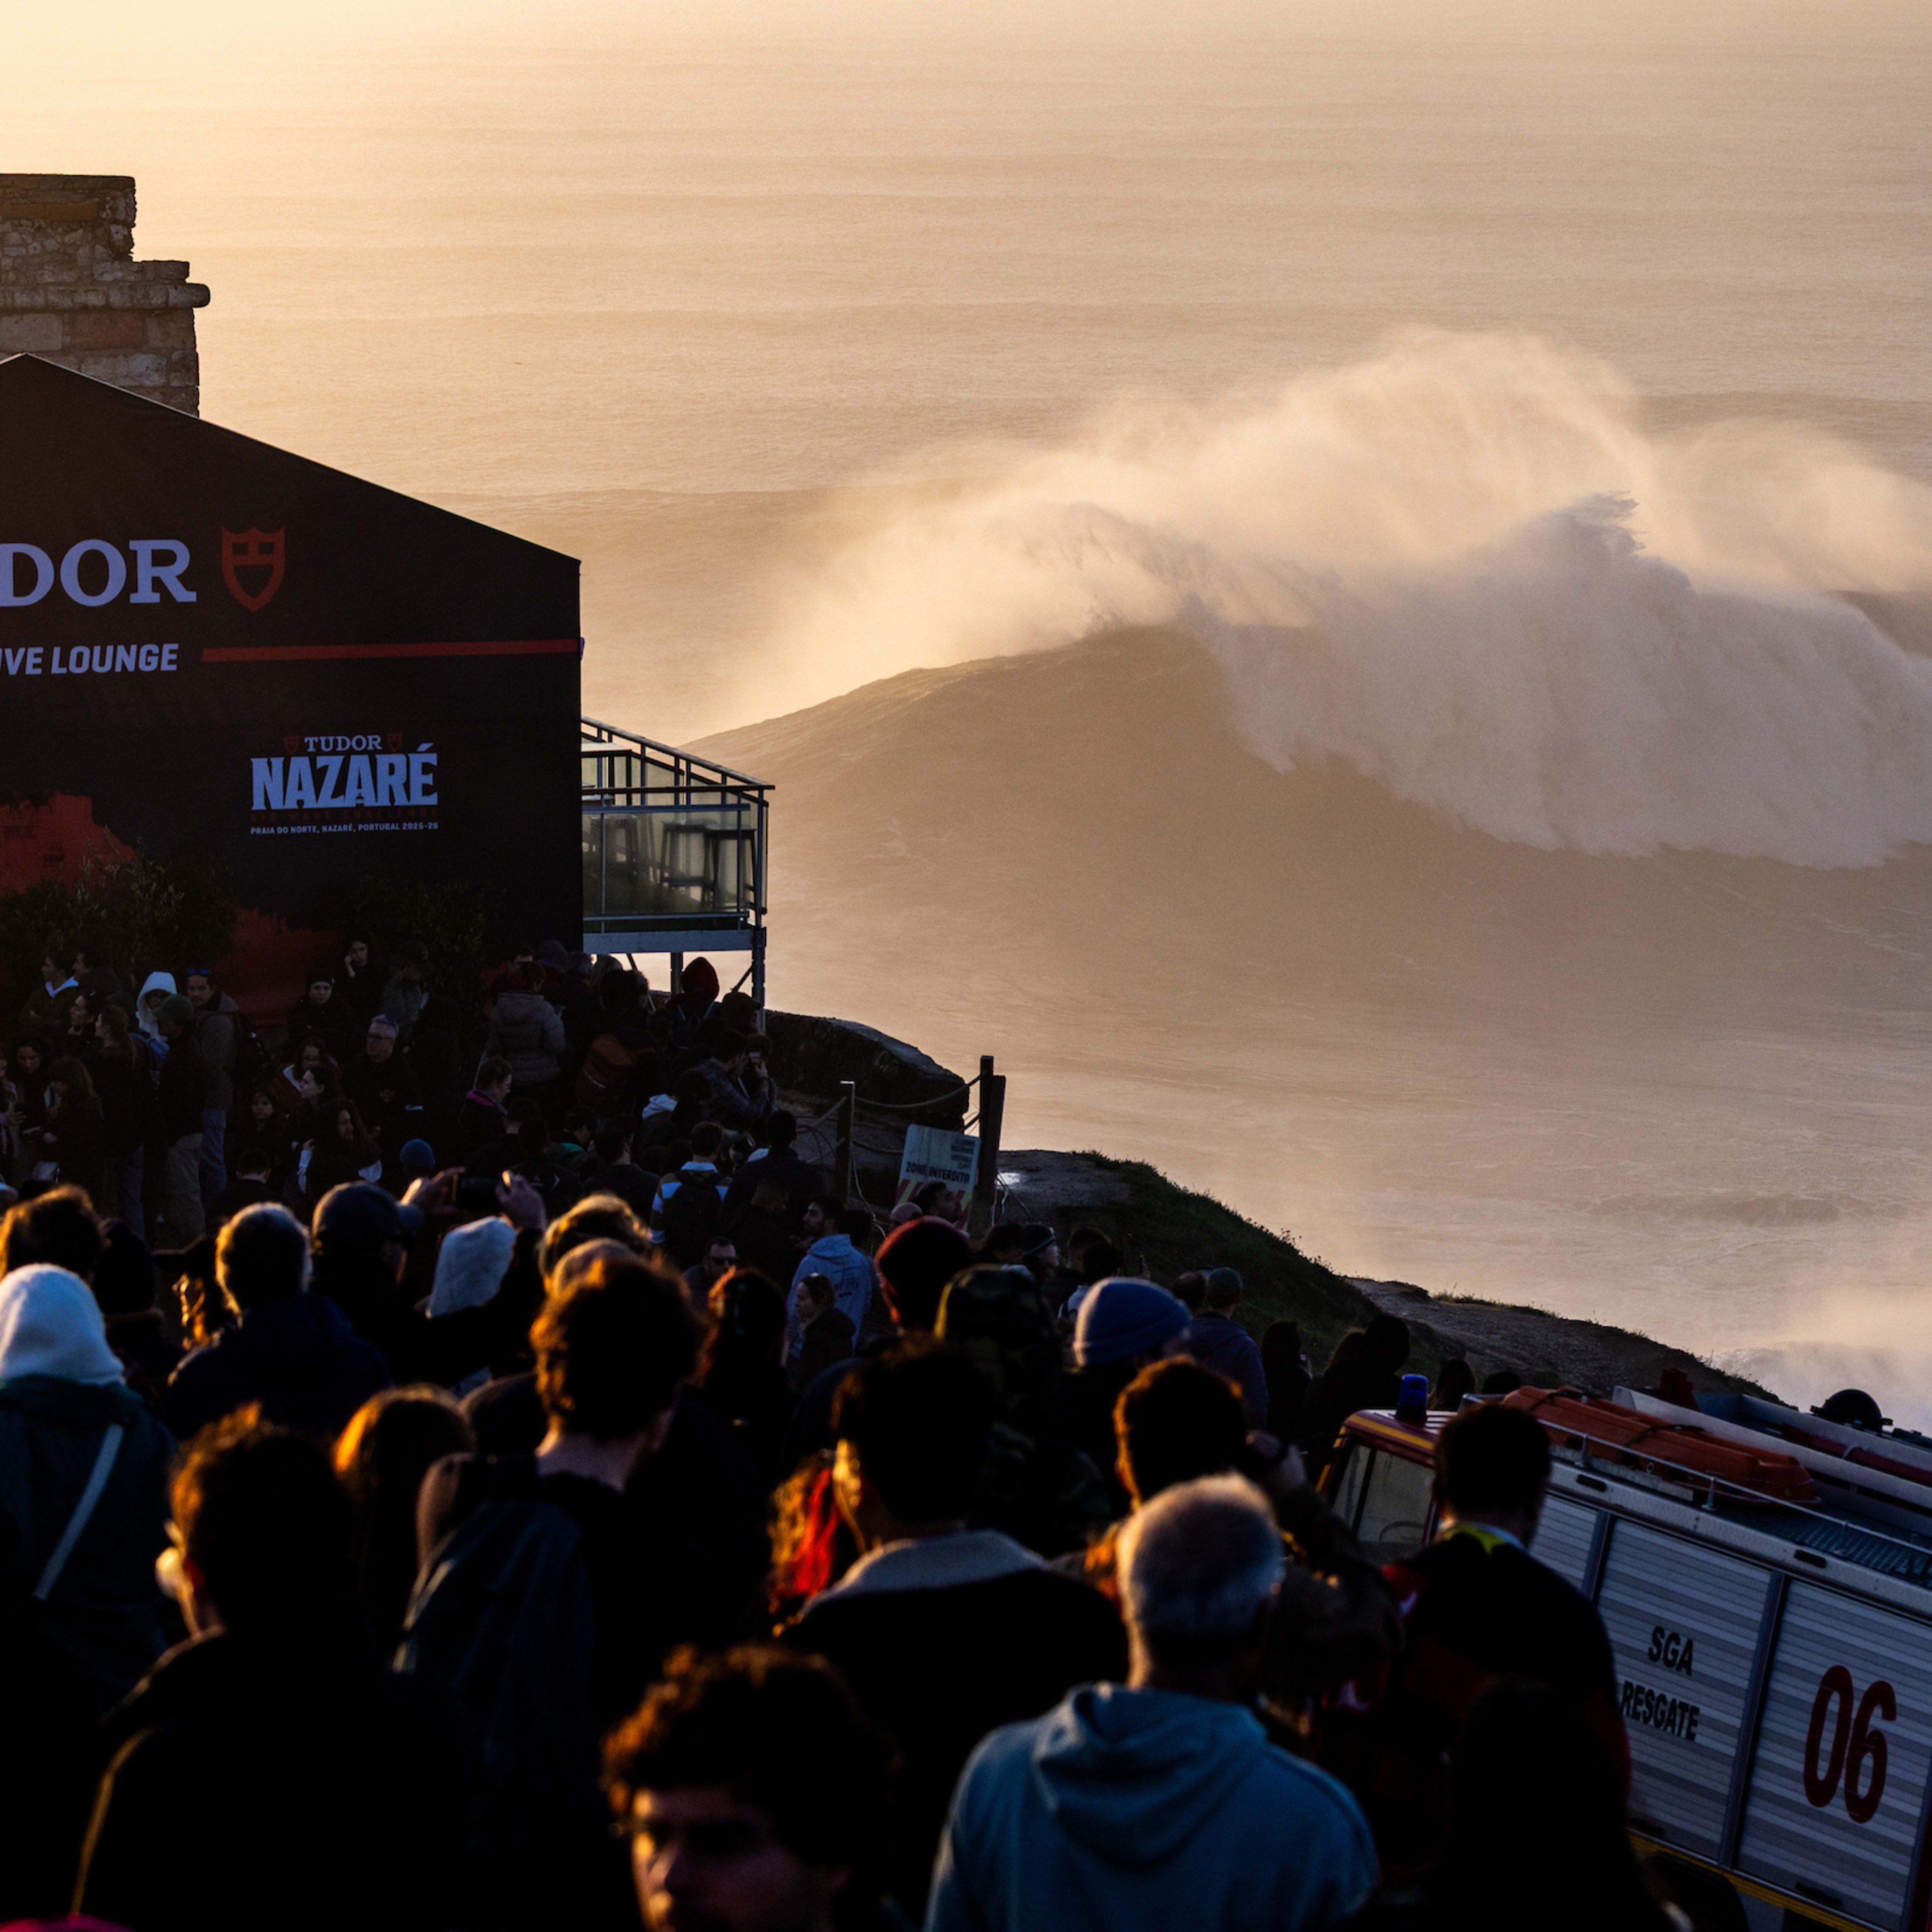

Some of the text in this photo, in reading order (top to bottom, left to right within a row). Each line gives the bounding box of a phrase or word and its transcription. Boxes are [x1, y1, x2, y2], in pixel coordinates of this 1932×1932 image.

[51, 643, 179, 674] LOUNGE
[304, 735, 382, 752] TUDOR
[251, 743, 438, 811] NAZARÉ
[290, 825, 320, 834] NORTE,
[358, 823, 400, 831] PORTUGAL
[402, 821, 438, 830] 2025-26
[1648, 1626, 1693, 1676] SGA
[1620, 1680, 1700, 1742] RESGATE
[1804, 1665, 1897, 1824] 06
